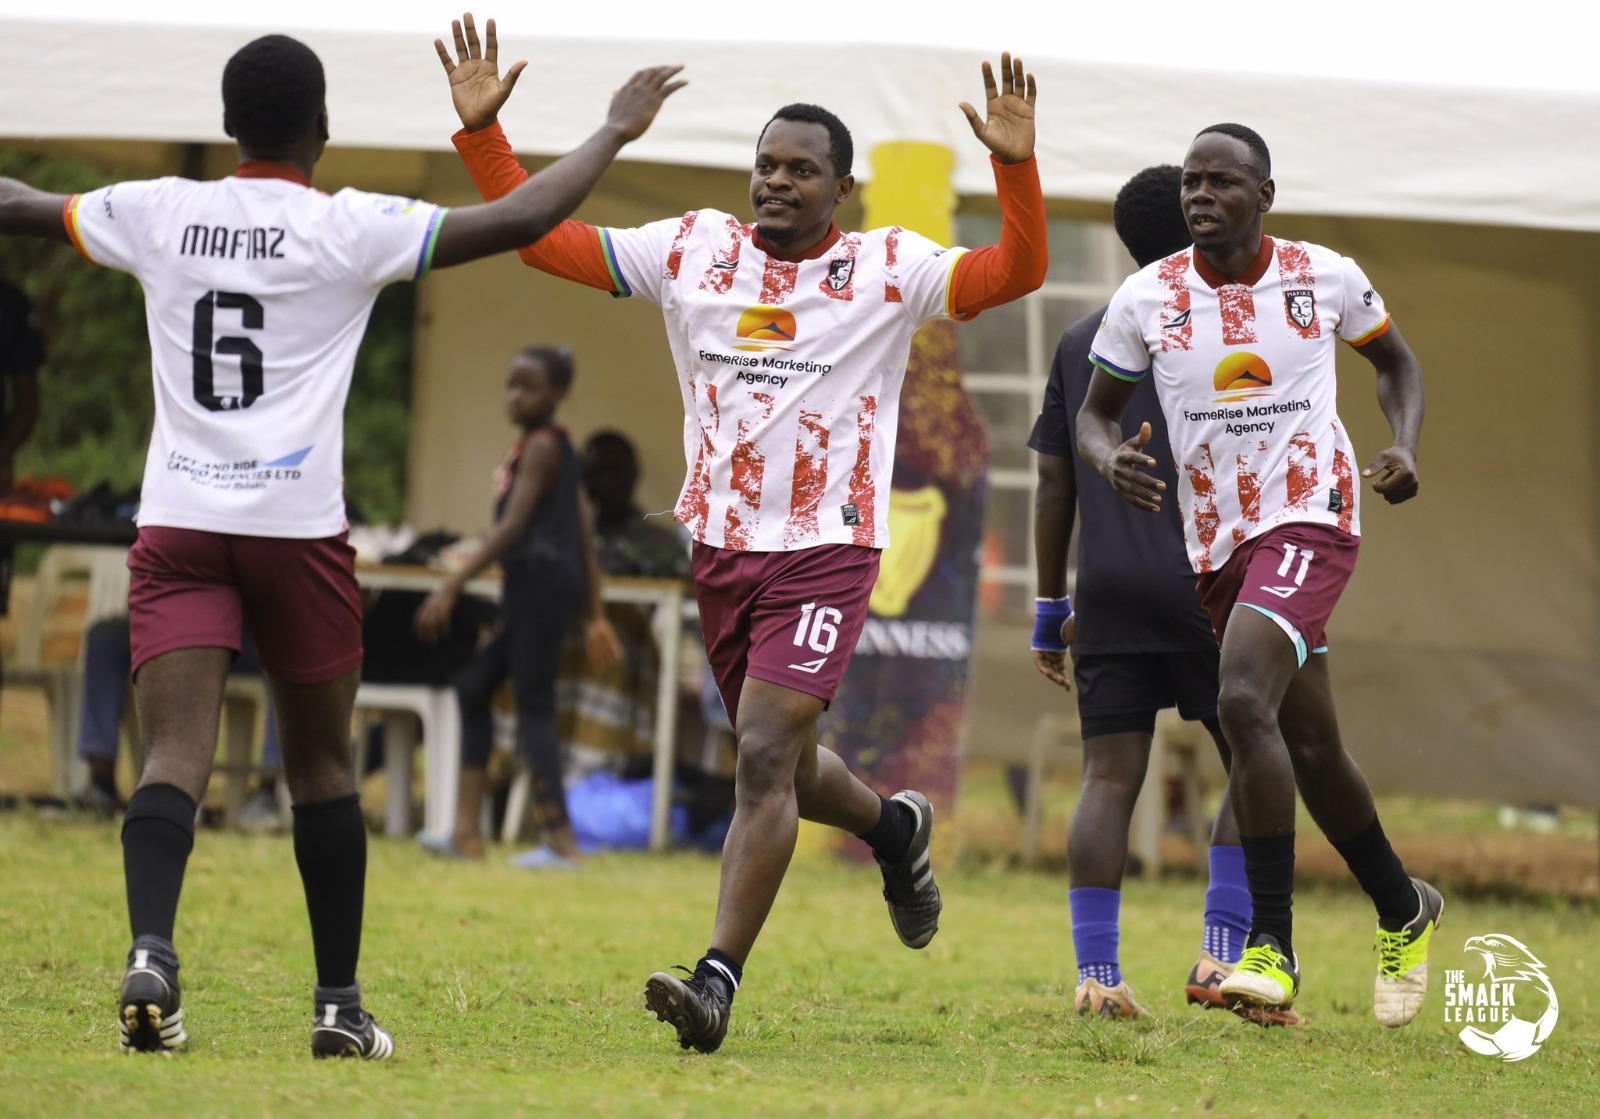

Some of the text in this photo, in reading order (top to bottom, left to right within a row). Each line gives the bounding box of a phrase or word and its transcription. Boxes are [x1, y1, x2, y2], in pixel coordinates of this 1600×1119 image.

[180, 224, 285, 260] MAFIAZ
[192, 289, 265, 412] 6
[699, 350, 832, 376] FameRise Marketing
[736, 371, 788, 389] Agency
[1184, 399, 1311, 421] FameRise Marketing
[1225, 421, 1275, 436] Agency
[232, 460, 258, 470] RIDE
[275, 470, 301, 480] LTD
[1276, 542, 1315, 587] 11
[793, 601, 843, 654] 16
